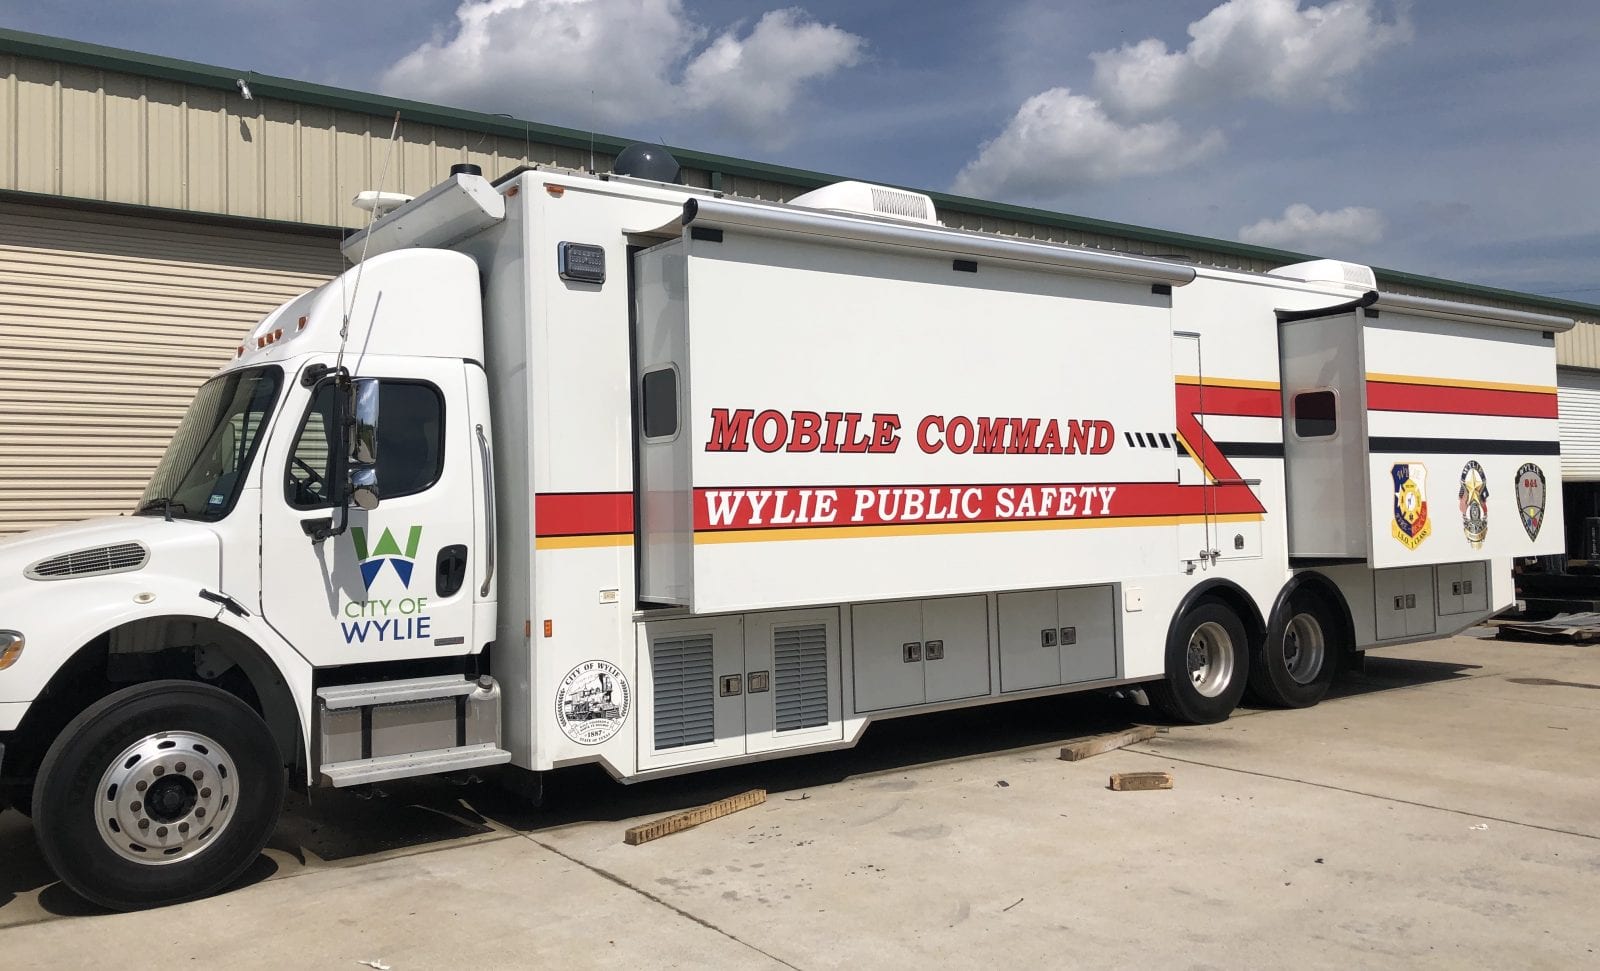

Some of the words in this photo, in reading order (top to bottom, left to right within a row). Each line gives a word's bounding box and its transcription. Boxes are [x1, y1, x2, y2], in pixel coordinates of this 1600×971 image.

[705, 408, 902, 454] MOBILE
[916, 415, 1116, 456] COMMAND
[705, 489, 838, 526] WYLIE
[851, 487, 983, 522] PUBLIC
[995, 486, 1117, 518] SAFETY
[344, 599, 392, 618] CITY
[399, 597, 428, 615] OF
[341, 617, 431, 644] WYLIE
[565, 668, 580, 685] CITY
[584, 663, 594, 671] OF
[598, 663, 620, 678] WYLIE
[588, 730, 602, 738] 1887
